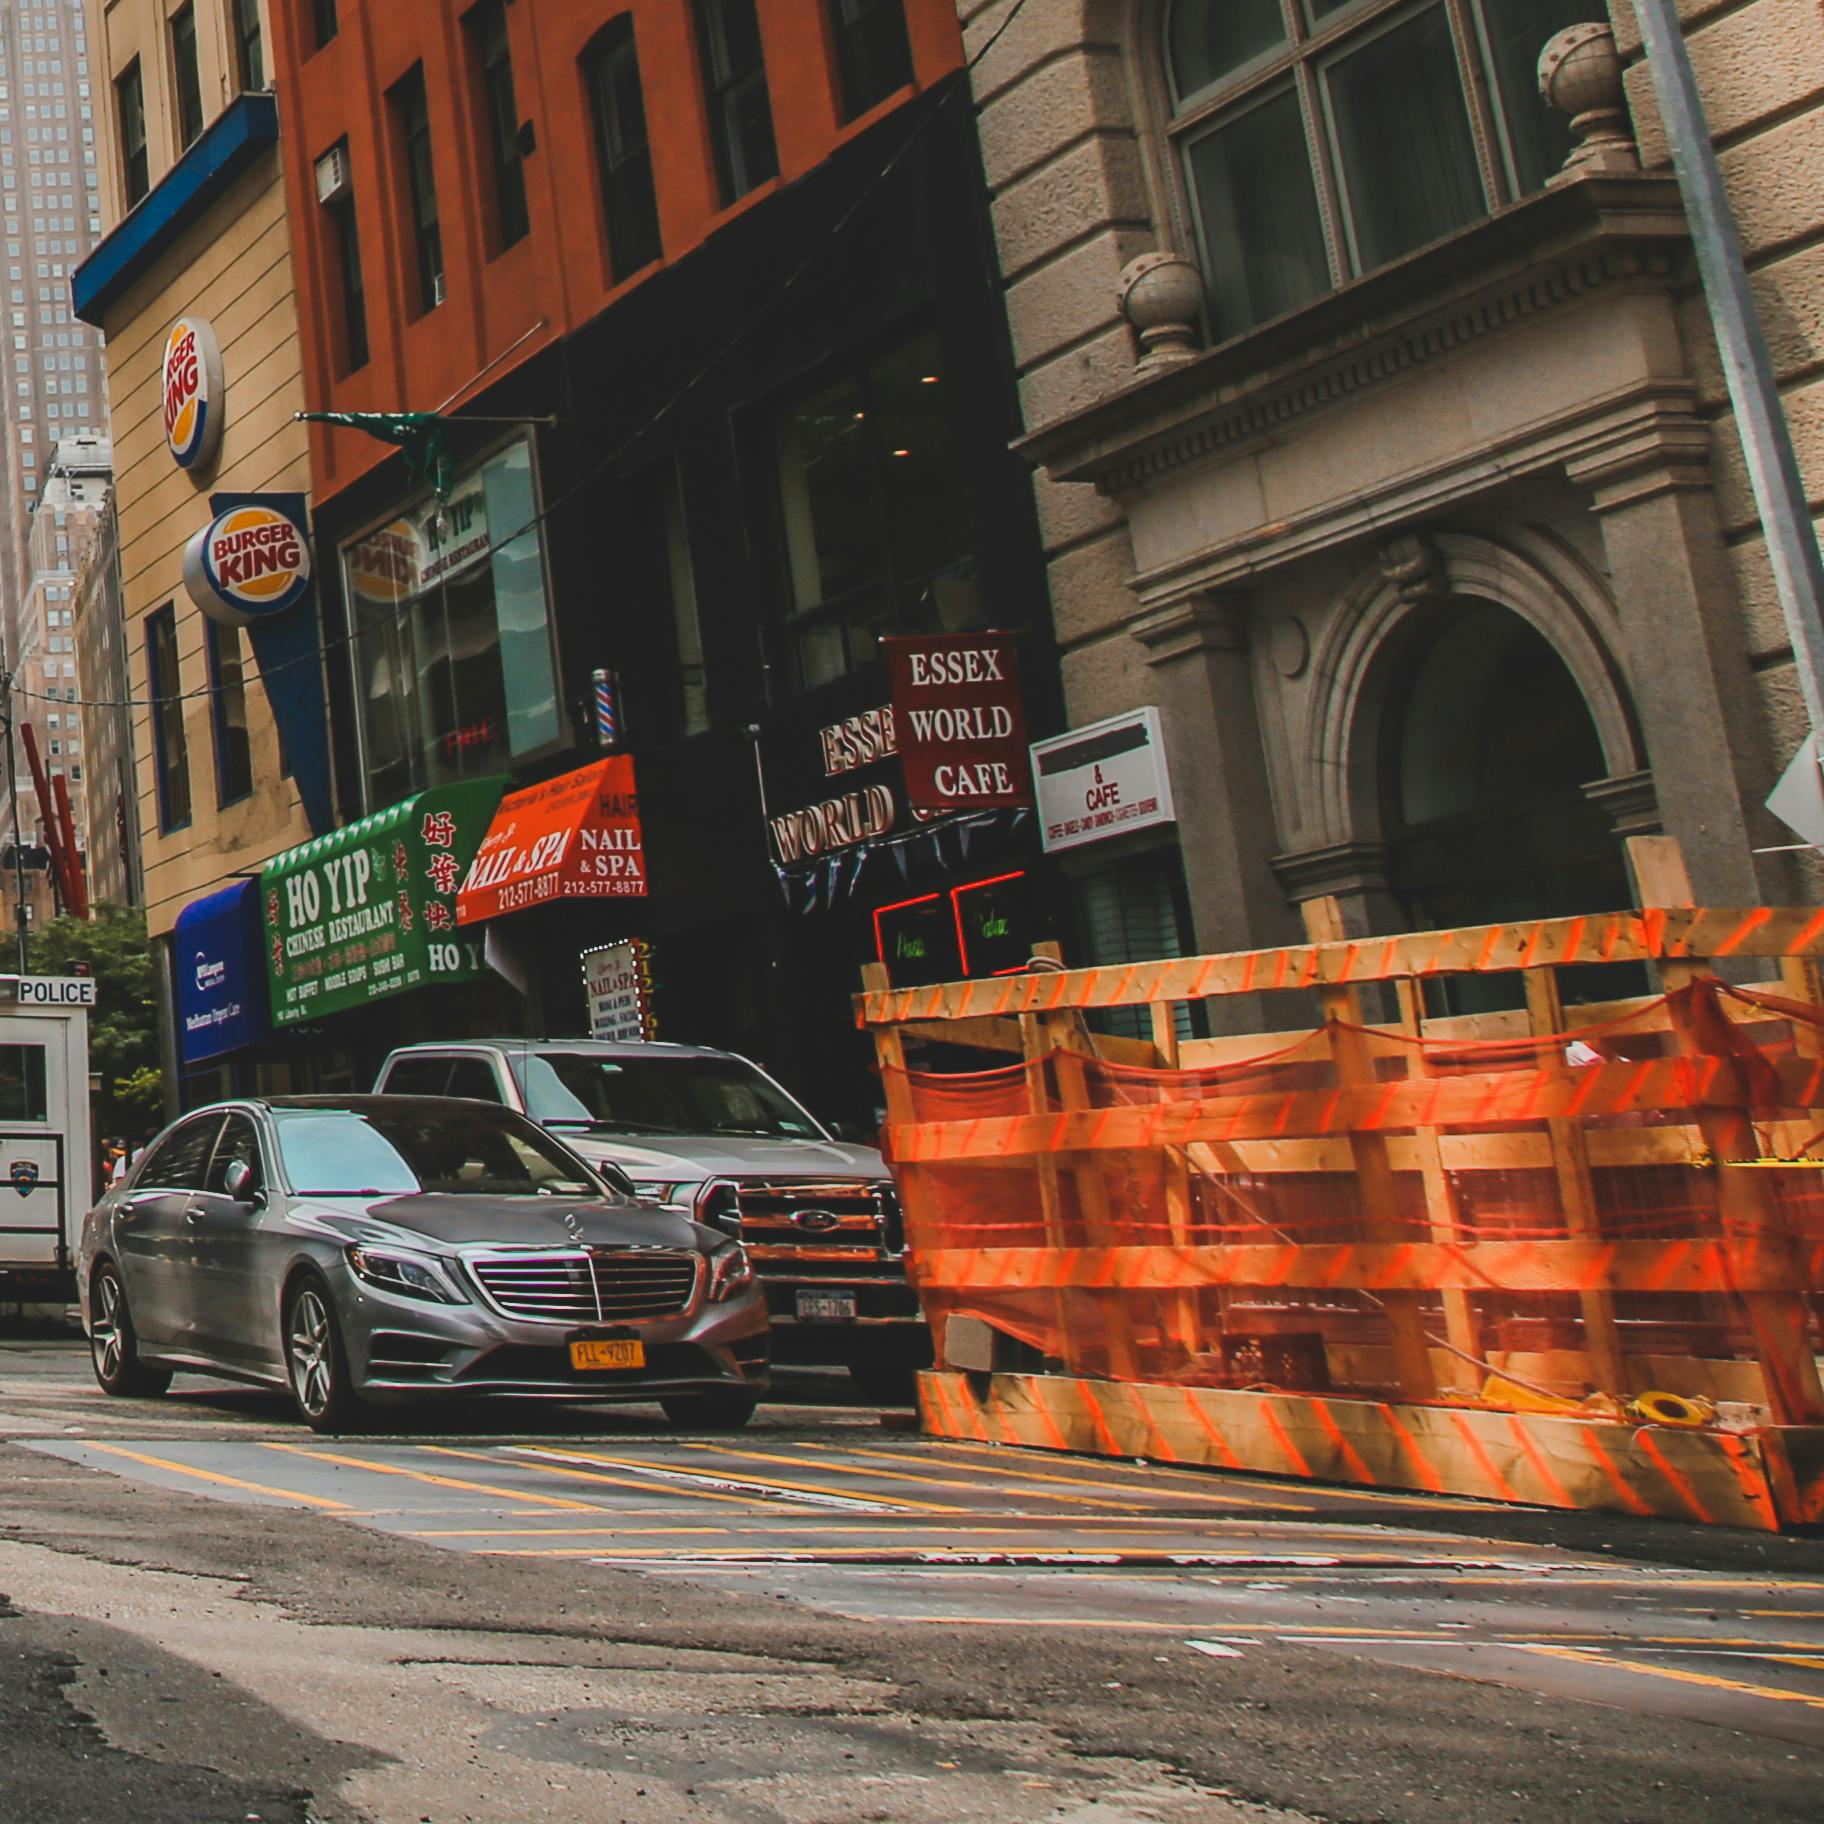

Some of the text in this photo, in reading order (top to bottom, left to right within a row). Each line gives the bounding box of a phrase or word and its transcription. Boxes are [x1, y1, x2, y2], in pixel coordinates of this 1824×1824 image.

[214, 523, 295, 561] BURGER
[219, 541, 300, 590] KING
[909, 650, 1003, 685] ESSEX
[819, 704, 898, 777] ESSE
[909, 706, 1012, 742] WORLD
[935, 763, 1013, 796] CAFE
[1086, 782, 1120, 811] CAFE
[599, 793, 638, 818] HAIR
[580, 829, 641, 850] NAIL
[770, 785, 894, 863] WORLD
[458, 828, 571, 894] NAIL & SPA
[581, 856, 640, 876] & SPA
[285, 848, 370, 928] HO YIP
[499, 872, 559, 910] 212-577-8877
[564, 881, 643, 893] 212-577-8877
[286, 925, 325, 958] CHINESE
[329, 900, 393, 943] RESTAURANT
[427, 943, 460, 971] HO
[20, 982, 92, 1002] POLICE
[589, 977, 613, 997] NAIL
